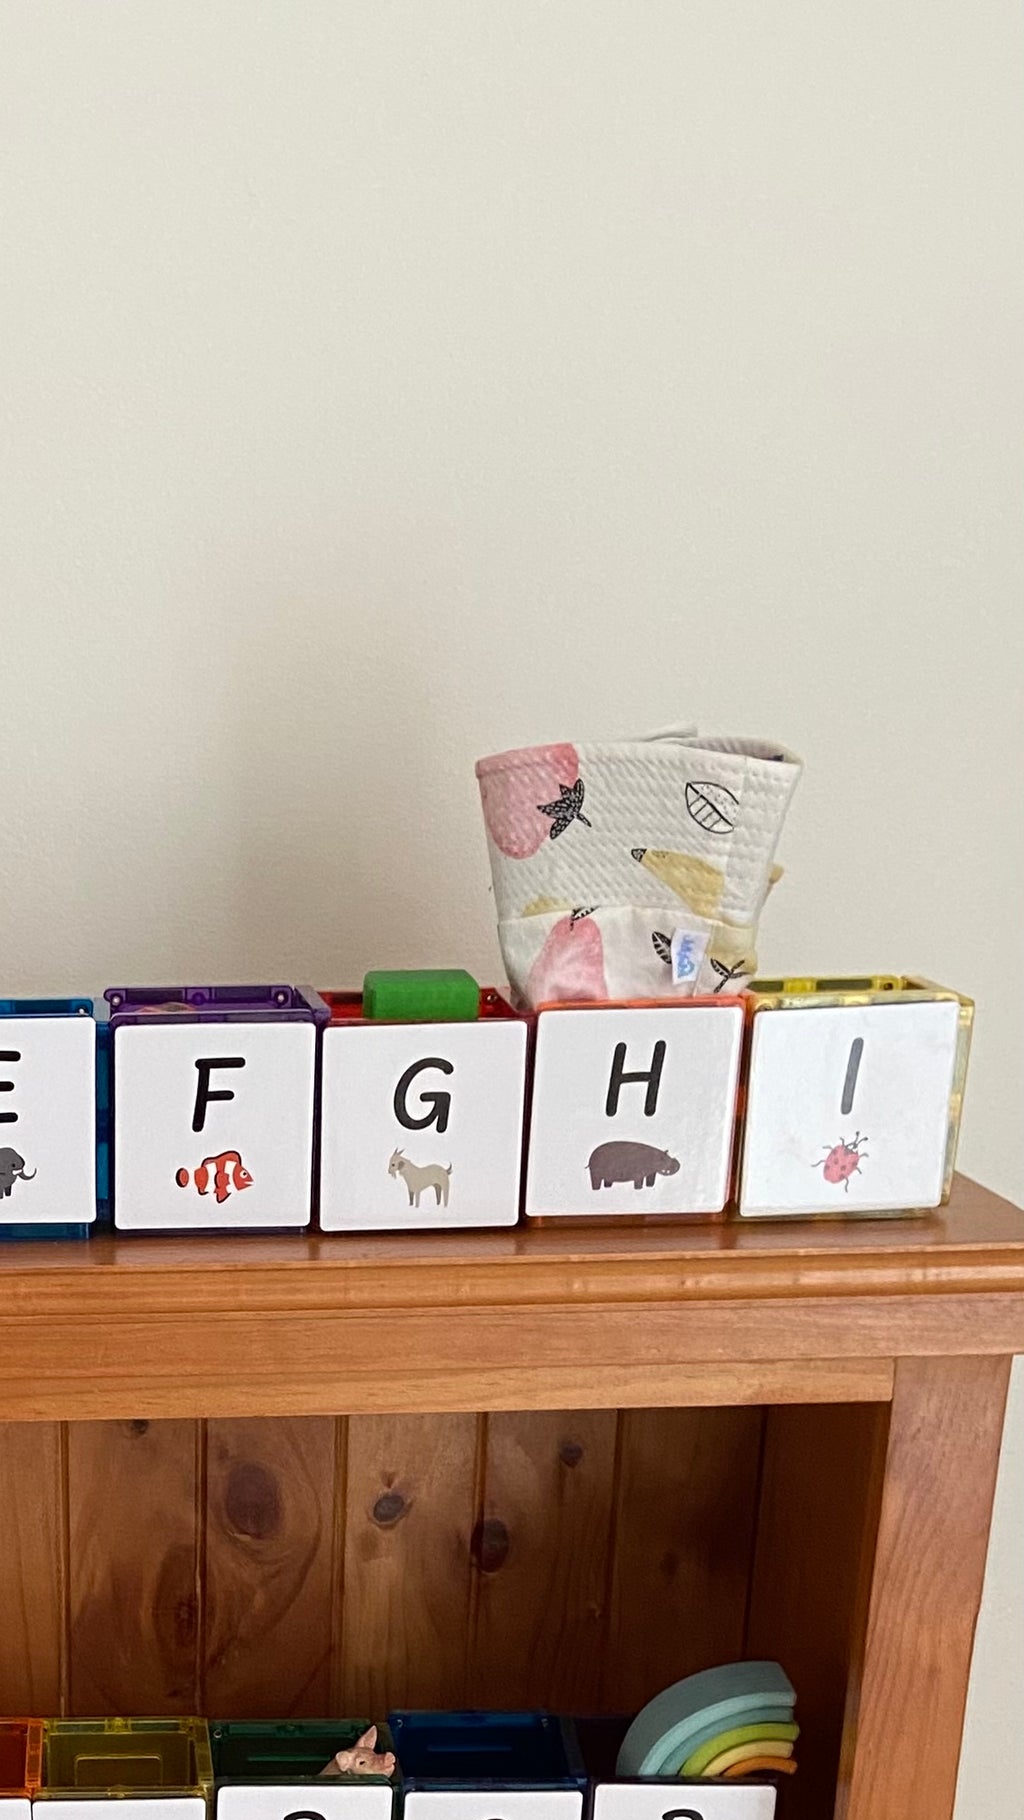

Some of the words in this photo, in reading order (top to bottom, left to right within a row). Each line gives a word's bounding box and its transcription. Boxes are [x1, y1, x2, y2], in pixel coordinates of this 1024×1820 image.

[191, 1056, 246, 1133] F
[393, 1057, 454, 1134] G
[605, 1039, 667, 1118] H
[840, 1037, 865, 1116] I
